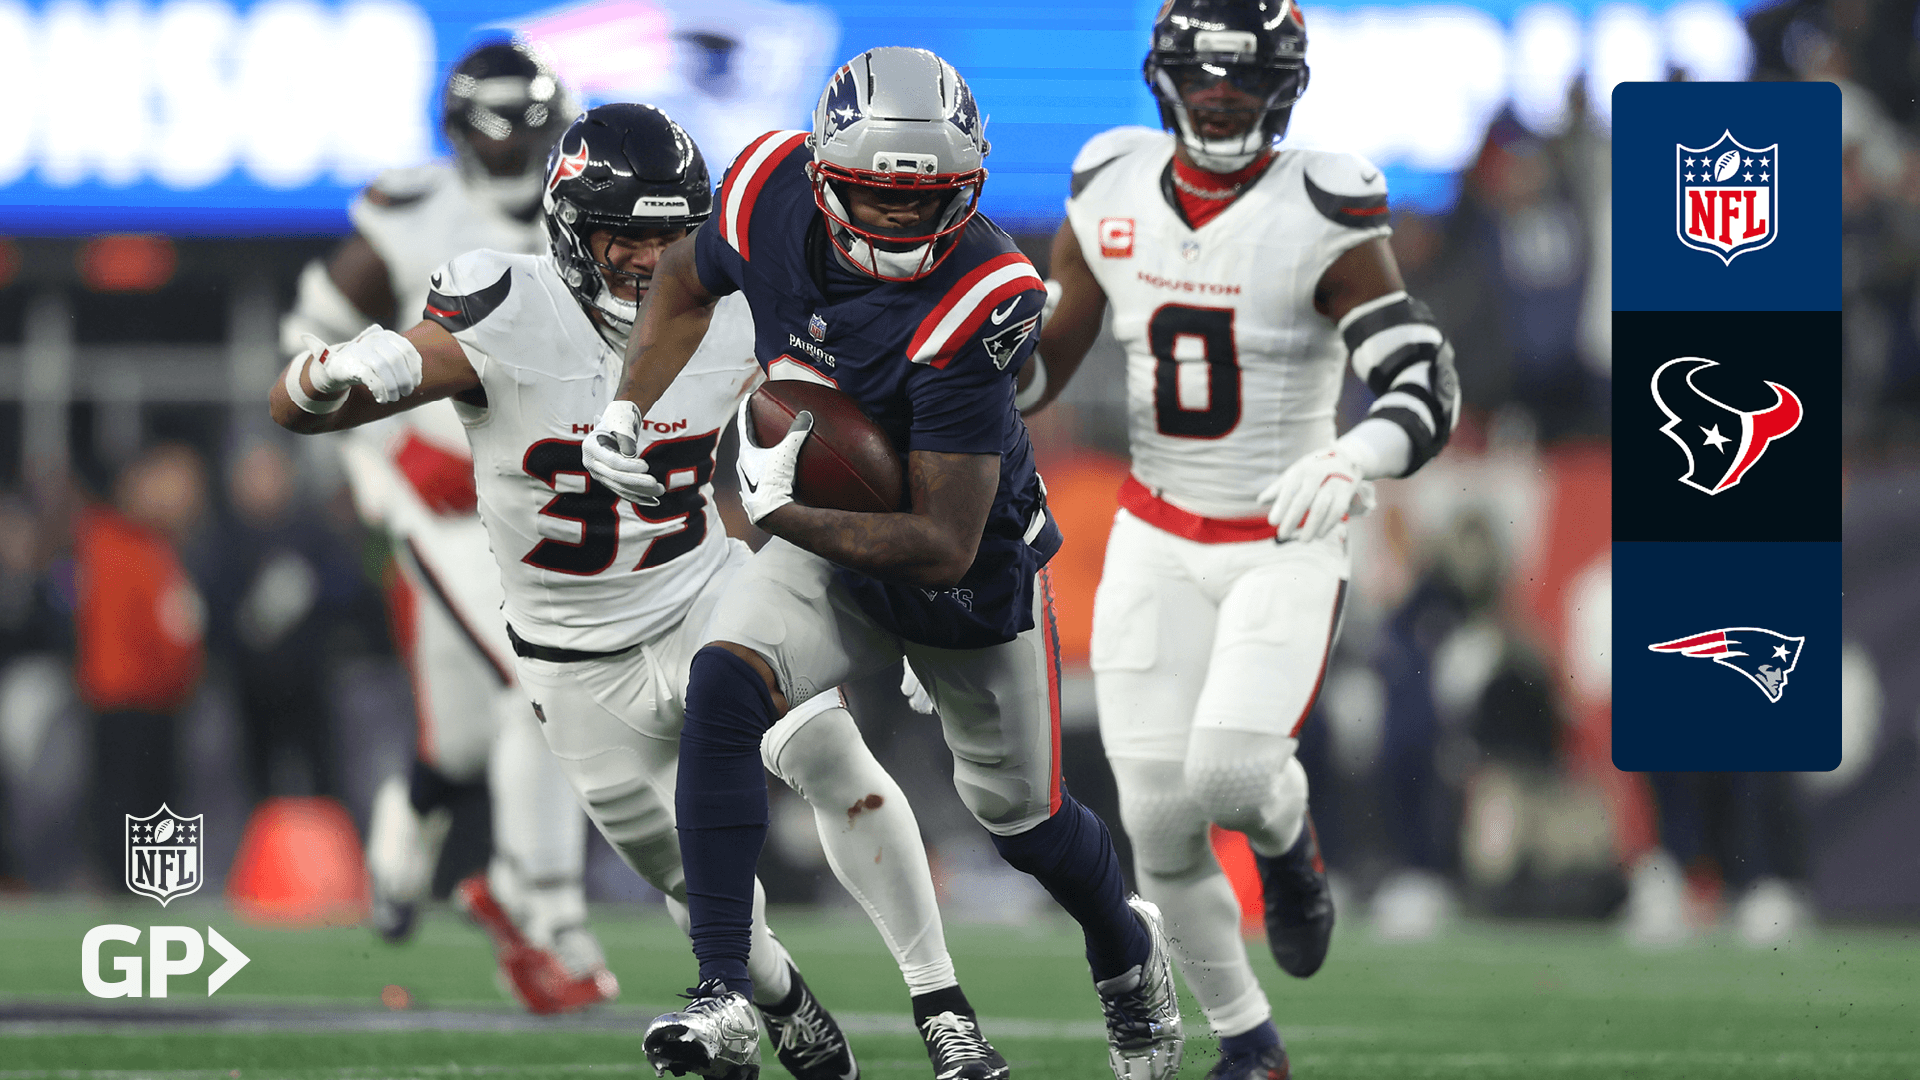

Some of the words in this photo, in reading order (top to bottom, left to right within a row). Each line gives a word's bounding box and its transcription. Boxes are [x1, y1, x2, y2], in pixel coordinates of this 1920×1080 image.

[1100, 219, 1131, 248] C
[1138, 271, 1241, 294] HOUSTON
[789, 333, 835, 368] PATRIOTS
[1148, 302, 1243, 440] 0
[572, 418, 687, 434] HTON
[521, 427, 720, 576] 39
